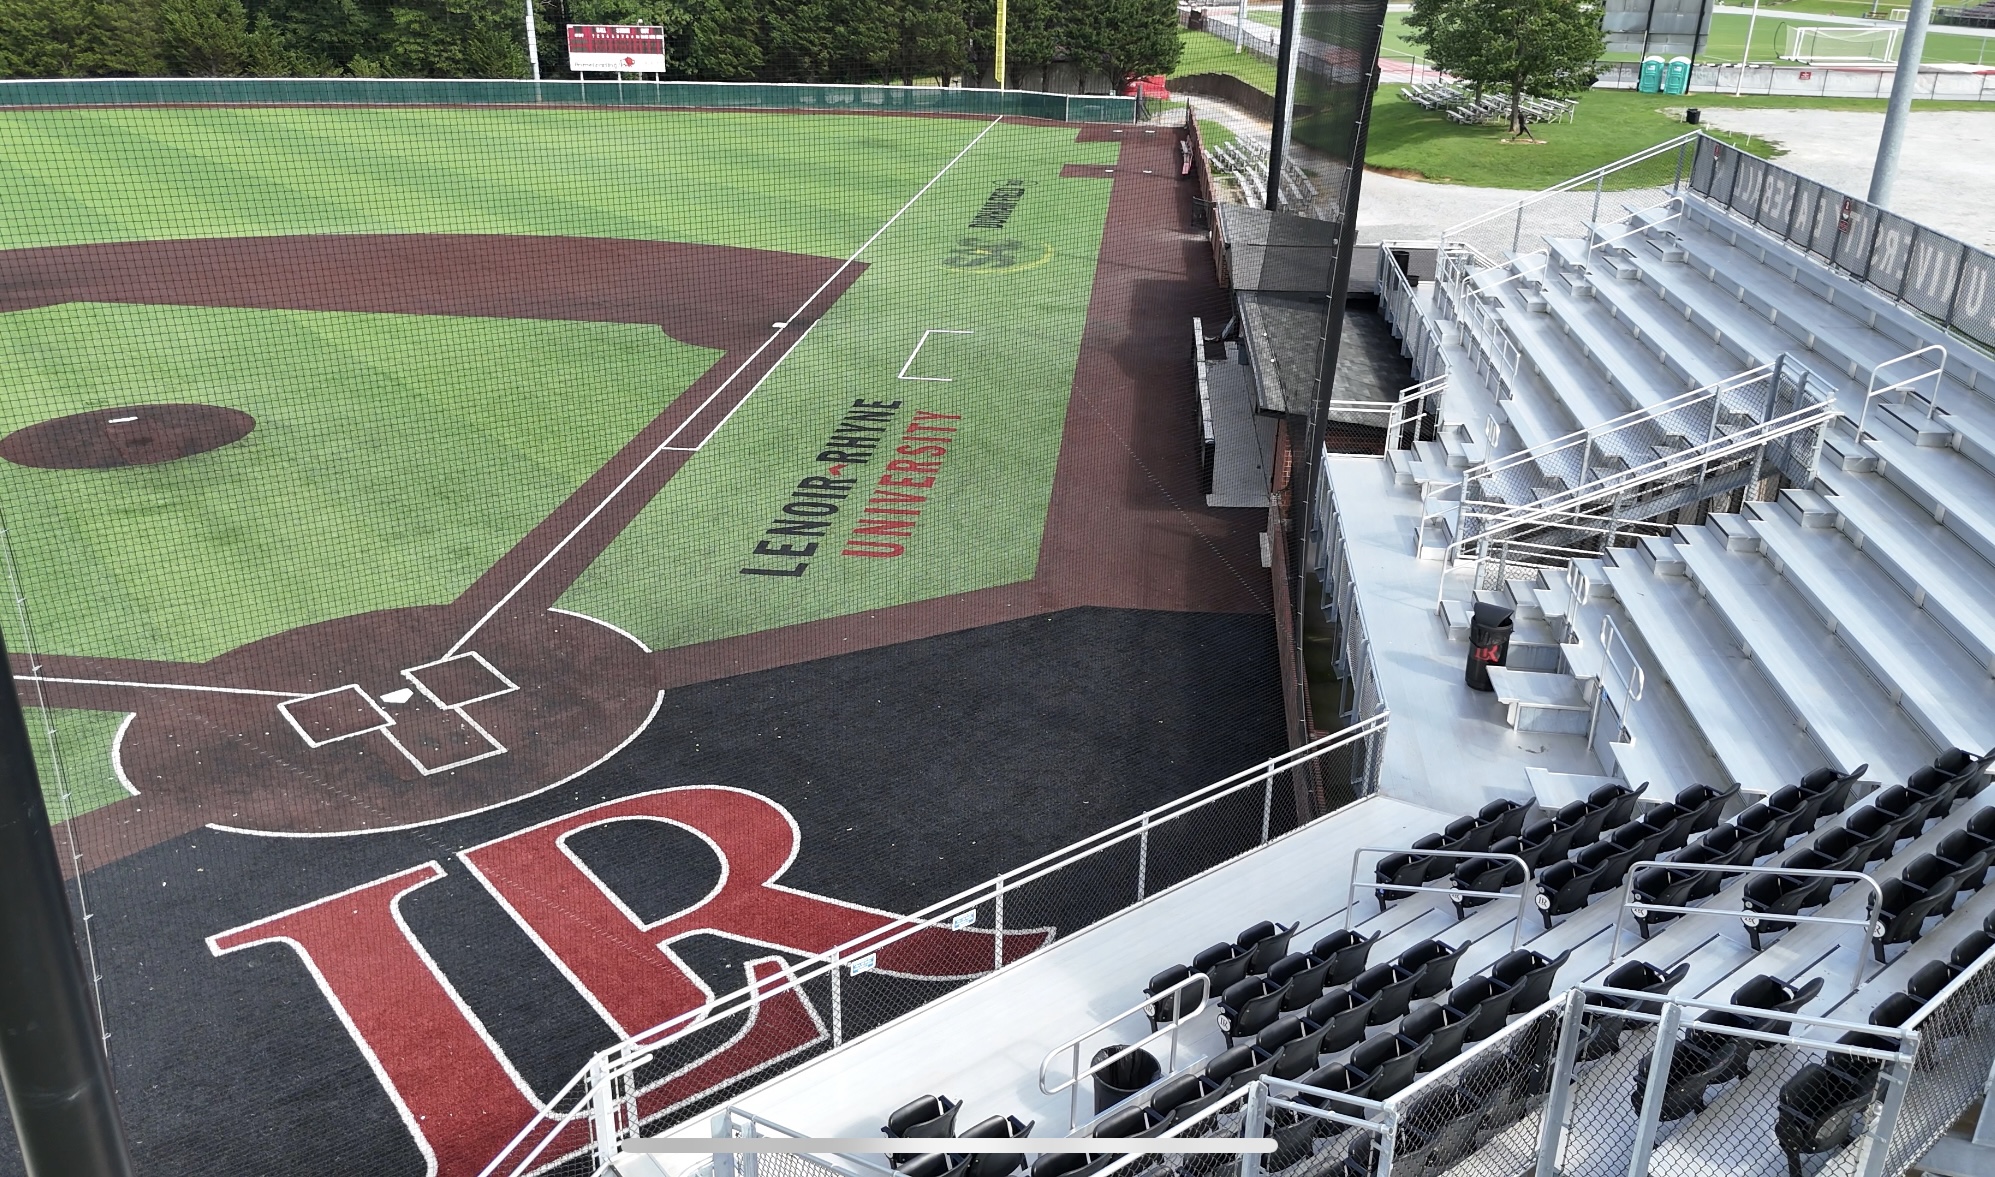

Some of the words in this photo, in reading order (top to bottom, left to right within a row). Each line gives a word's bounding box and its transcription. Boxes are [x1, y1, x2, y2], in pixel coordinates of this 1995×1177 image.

[841, 410, 961, 558] UNIVERSITY
[1474, 644, 1498, 662] LR
[205, 784, 1056, 1177] LR
